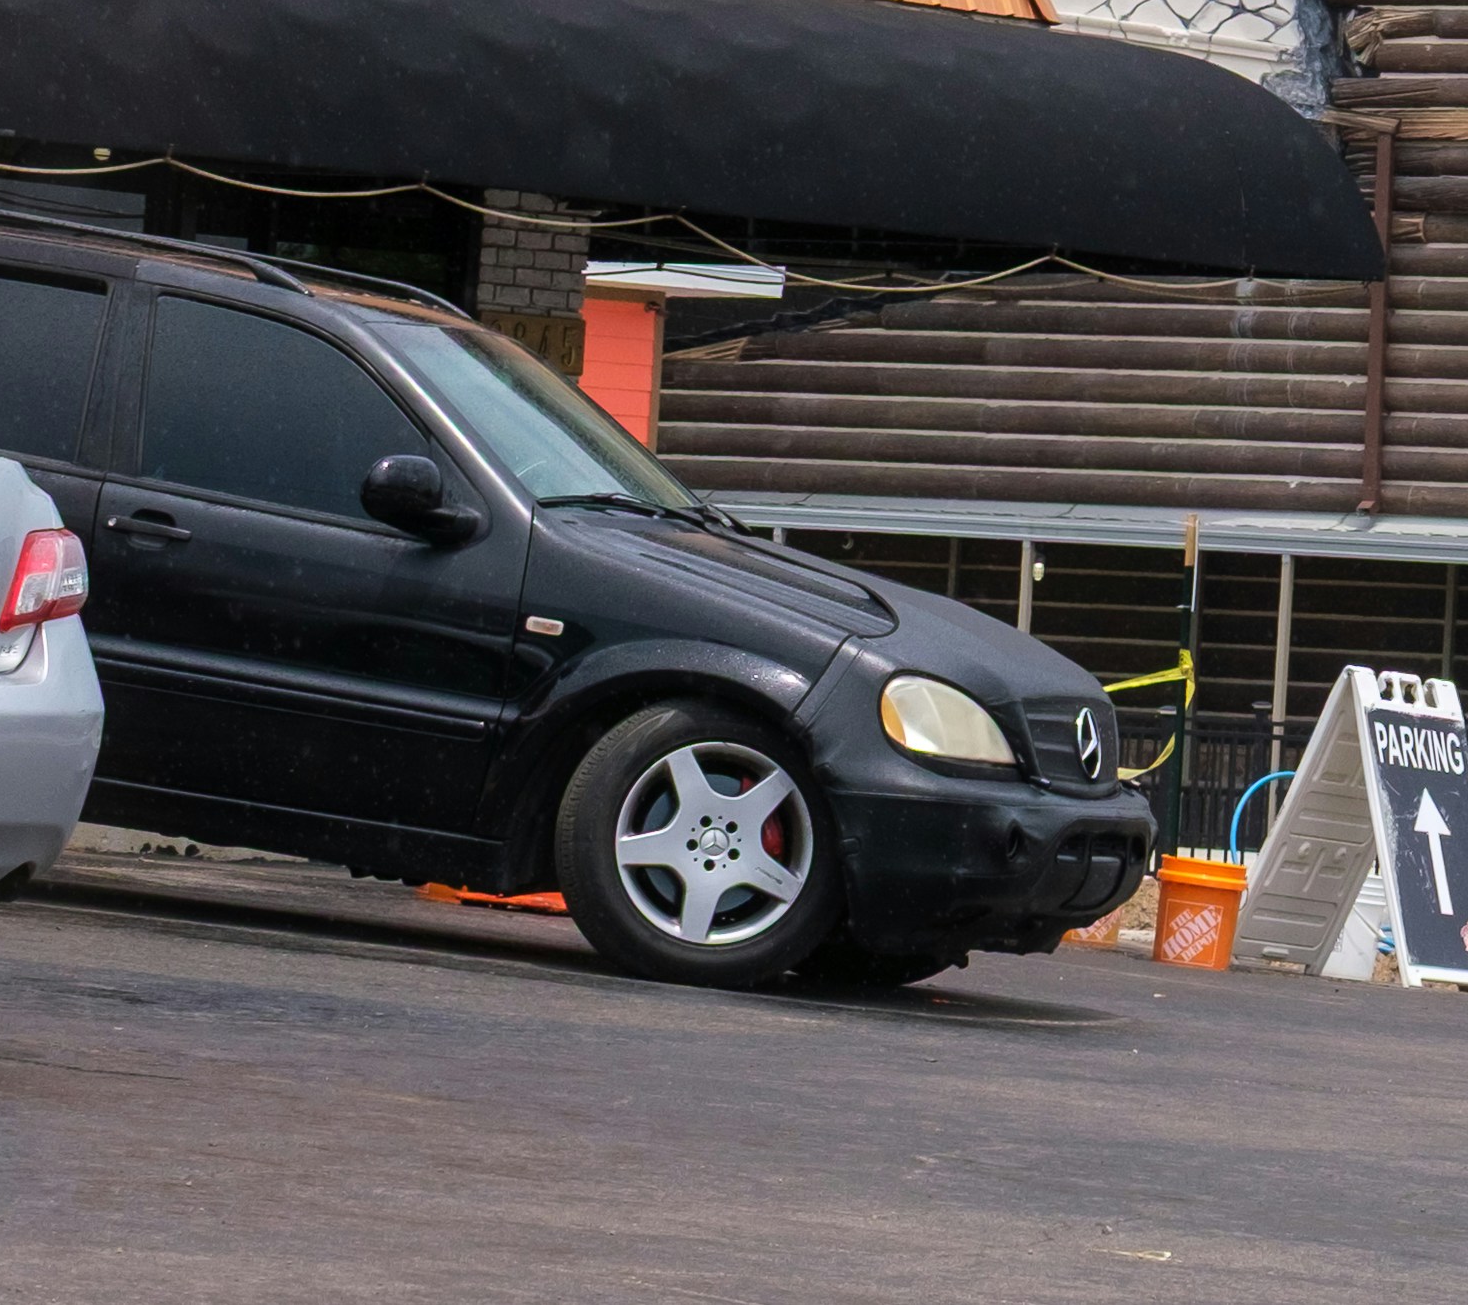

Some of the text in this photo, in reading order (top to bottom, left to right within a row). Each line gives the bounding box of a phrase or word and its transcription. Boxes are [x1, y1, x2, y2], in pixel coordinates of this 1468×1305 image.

[1373, 720, 1465, 776] PARKING
[1162, 904, 1221, 960] HOME
[1169, 907, 1194, 931] THE
[1180, 928, 1218, 963] DEPOT
